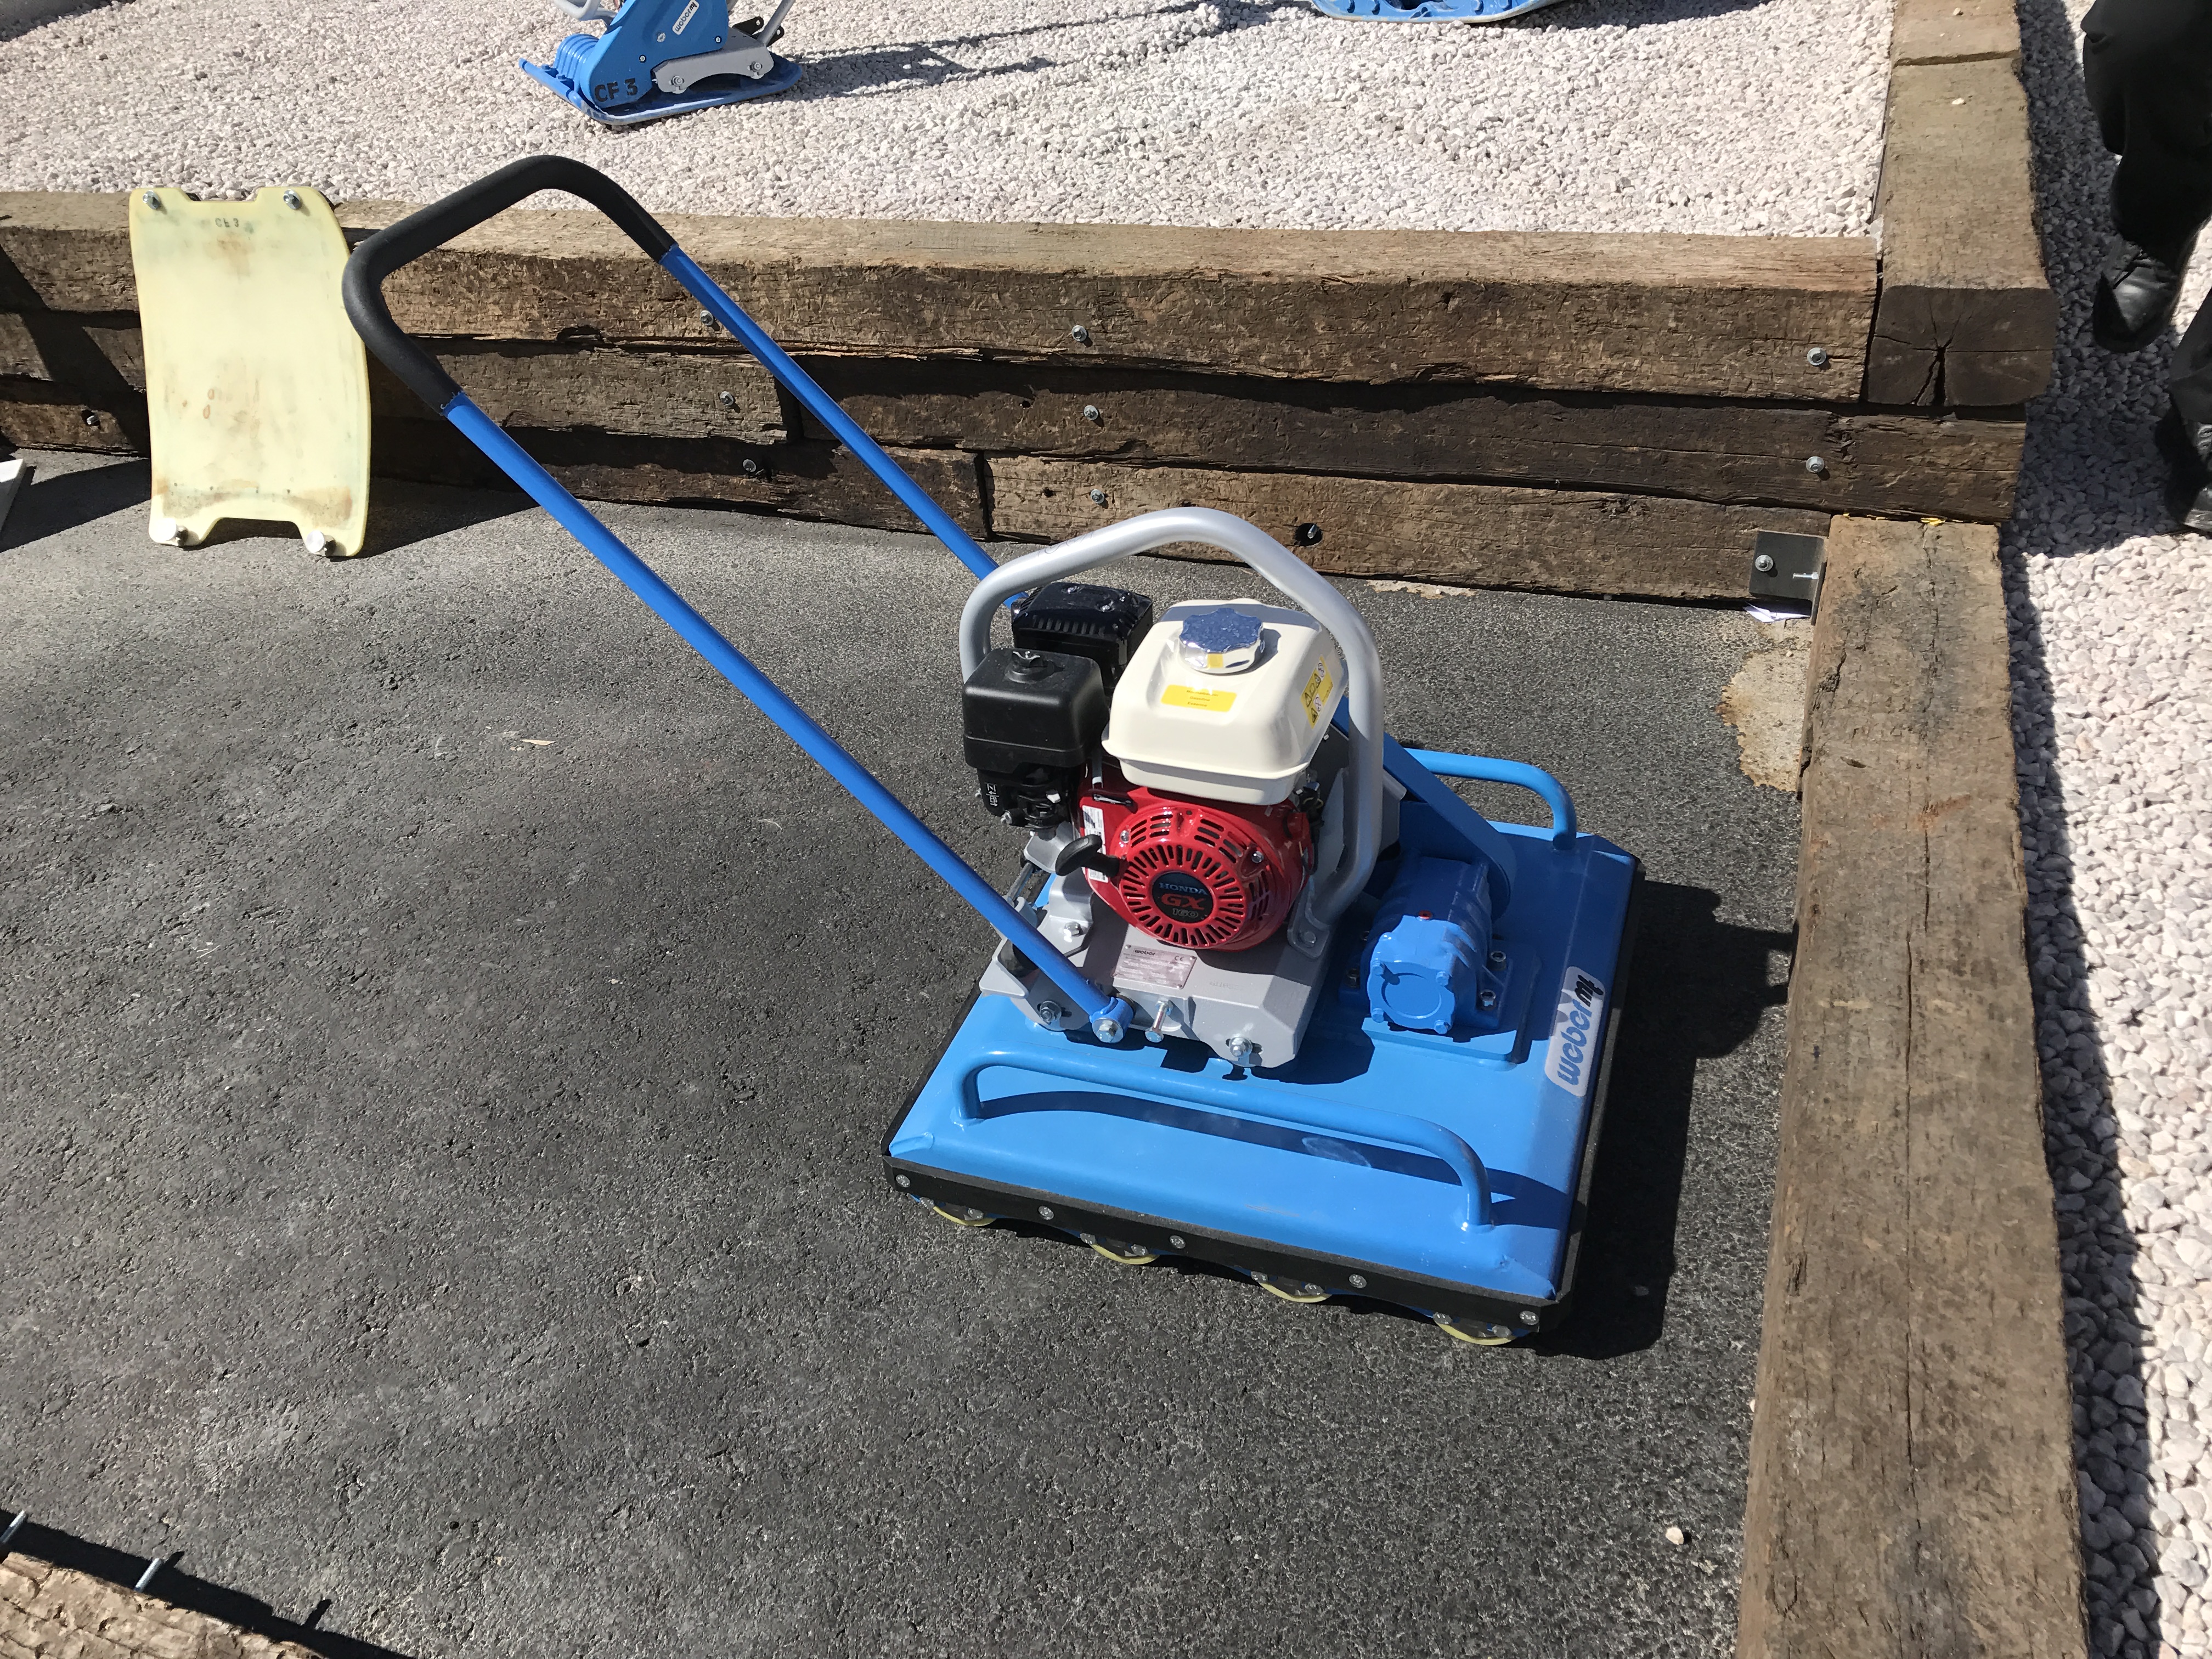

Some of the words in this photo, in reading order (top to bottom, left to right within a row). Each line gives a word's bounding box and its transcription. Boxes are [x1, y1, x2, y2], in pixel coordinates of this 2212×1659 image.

[594, 81, 619, 102] CF
[624, 78, 638, 95] 3
[1159, 882, 1208, 895] HONDA
[1161, 893, 1205, 910] GX
[1172, 908, 1199, 918] 160
[1557, 998, 1592, 1085] weber
